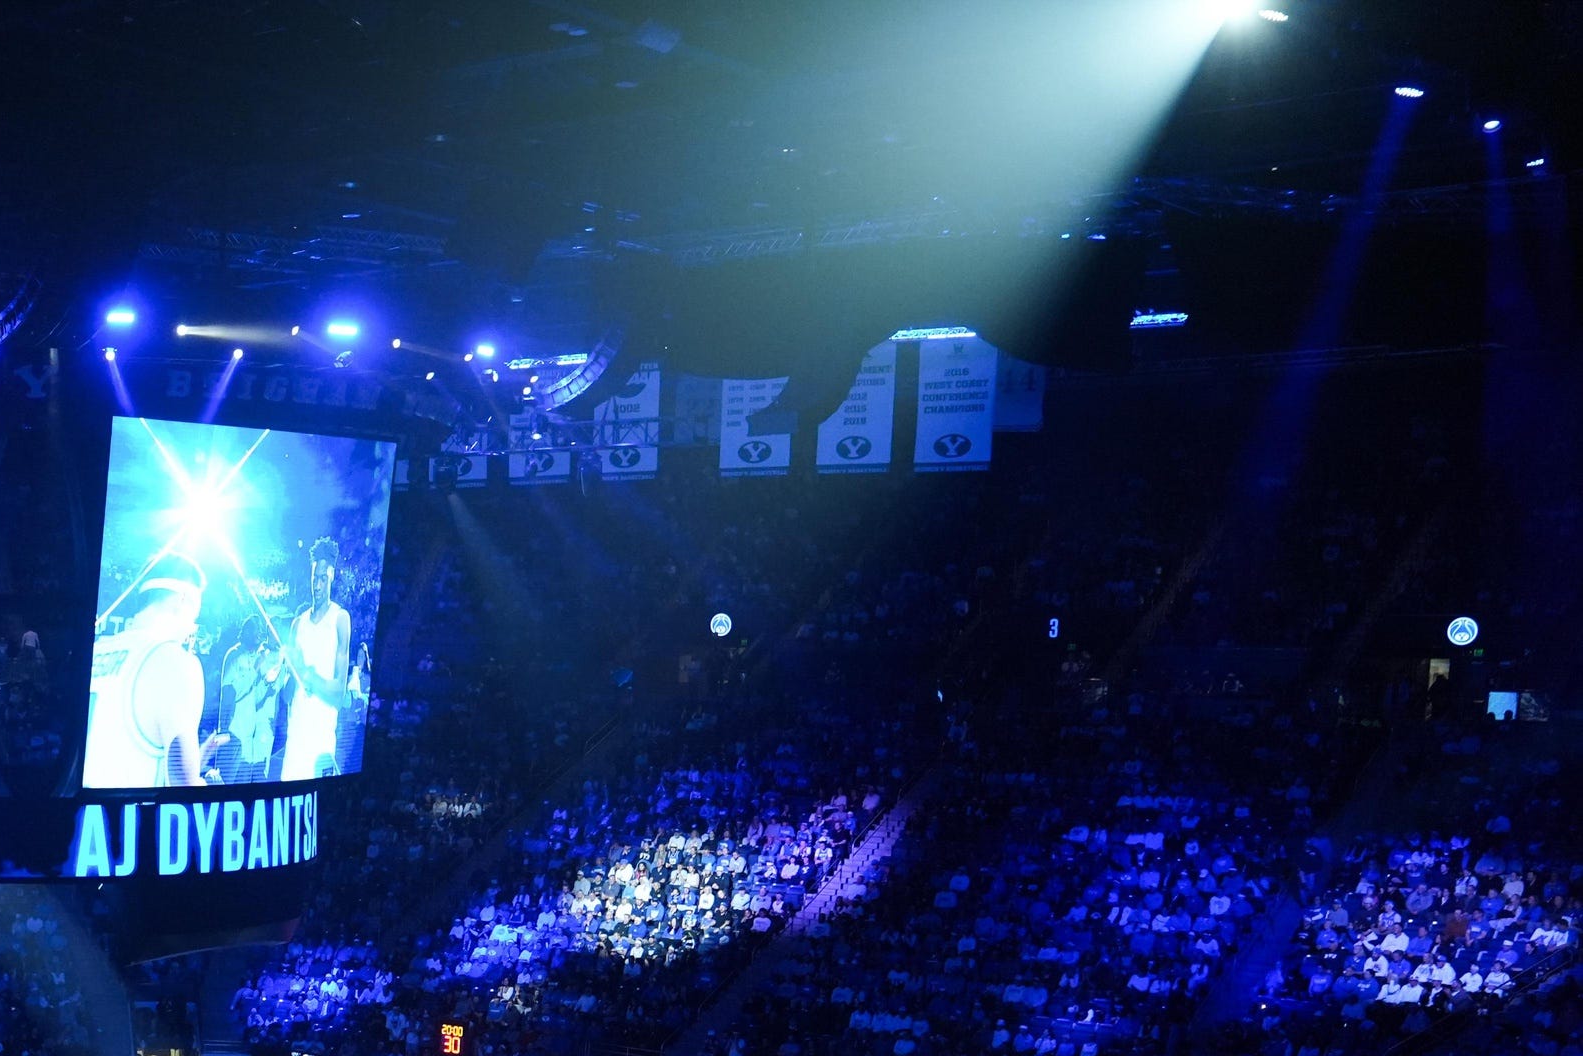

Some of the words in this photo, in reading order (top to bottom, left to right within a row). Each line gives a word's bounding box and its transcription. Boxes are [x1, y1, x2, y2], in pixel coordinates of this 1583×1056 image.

[922, 391, 988, 402] CONFERENCE
[924, 404, 986, 414] CHAMPIONS
[1049, 618, 1059, 638] 3
[75, 804, 139, 877] AJ
[158, 791, 318, 876] DYBANTSA
[441, 1024, 464, 1037] 20:00
[443, 1035, 461, 1054] 30
